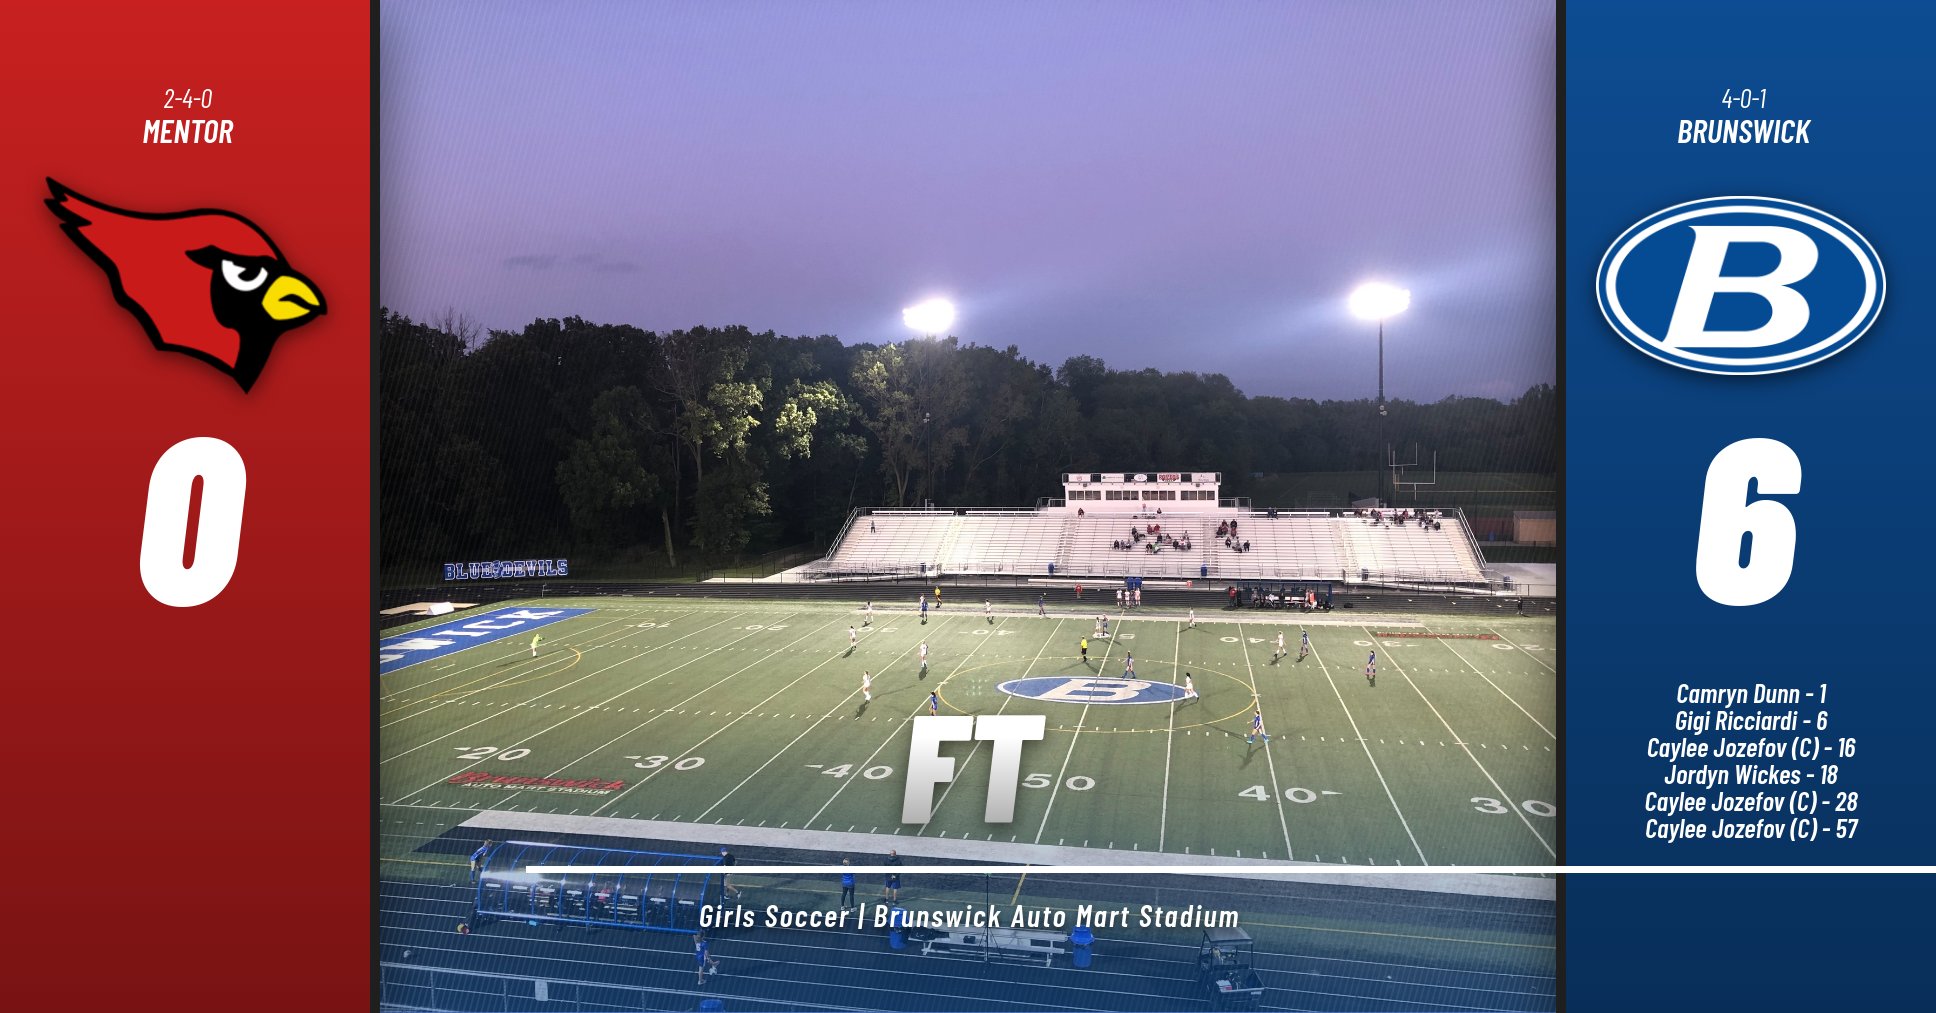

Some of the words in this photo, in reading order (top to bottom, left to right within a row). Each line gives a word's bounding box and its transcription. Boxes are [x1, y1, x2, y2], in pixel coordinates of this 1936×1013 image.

[444, 562, 493, 580] BLUE
[500, 559, 568, 578] DEVILS
[456, 746, 531, 761] 20
[634, 755, 705, 771] 30
[821, 763, 894, 780] 40
[1022, 773, 1096, 791] 50
[1238, 784, 1317, 803] 40
[1470, 796, 1556, 817] 30
